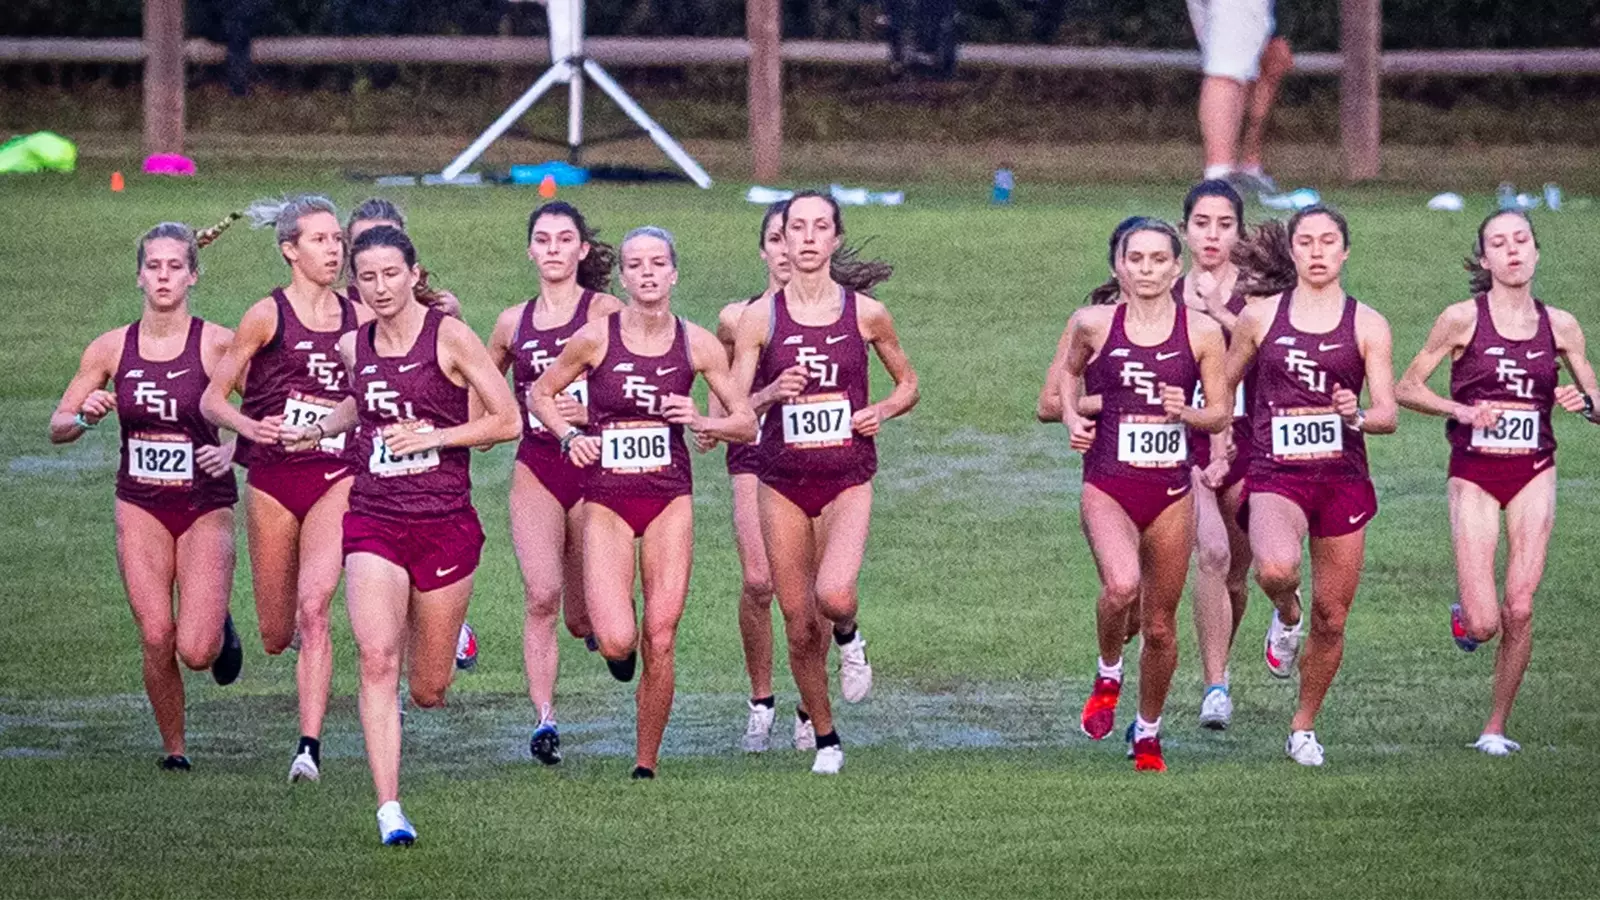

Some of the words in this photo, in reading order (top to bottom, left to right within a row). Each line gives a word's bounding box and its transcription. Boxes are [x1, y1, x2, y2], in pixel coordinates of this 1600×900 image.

[795, 346, 839, 387] FSU
[1284, 349, 1327, 393] FSU
[1496, 358, 1535, 398] FSU
[133, 382, 179, 421] FSU
[788, 408, 844, 436] 1307
[1280, 421, 1336, 447] 1305
[610, 435, 665, 460] 1306
[1127, 430, 1181, 454] 1308
[135, 447, 187, 473] 1322
